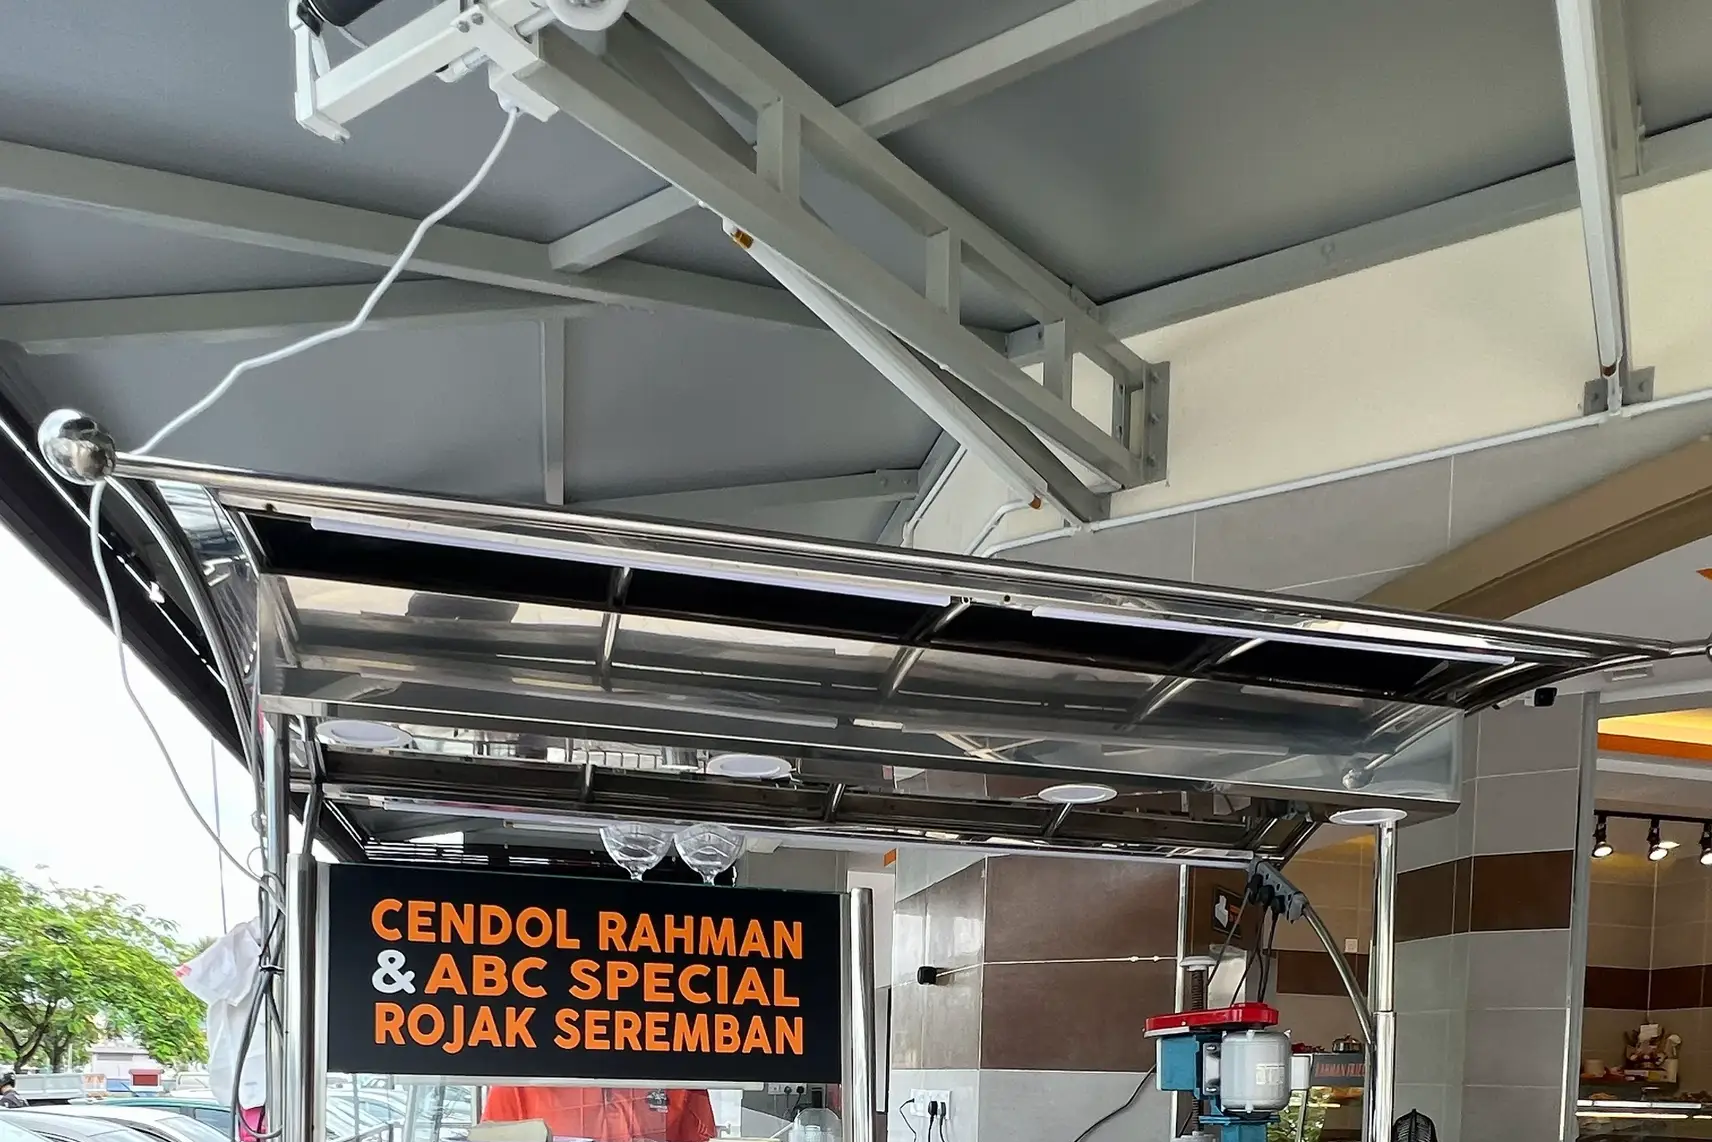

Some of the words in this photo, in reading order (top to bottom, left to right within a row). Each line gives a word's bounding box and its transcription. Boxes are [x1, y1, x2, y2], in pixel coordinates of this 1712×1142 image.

[371, 898, 580, 949] CENDOL
[598, 911, 803, 960] RAHMAN
[371, 949, 416, 994] &
[424, 953, 548, 999] ABC
[569, 958, 800, 1007] SPECIAL
[375, 1002, 537, 1055] ROJAK
[554, 1008, 803, 1056] SEREMBAN
